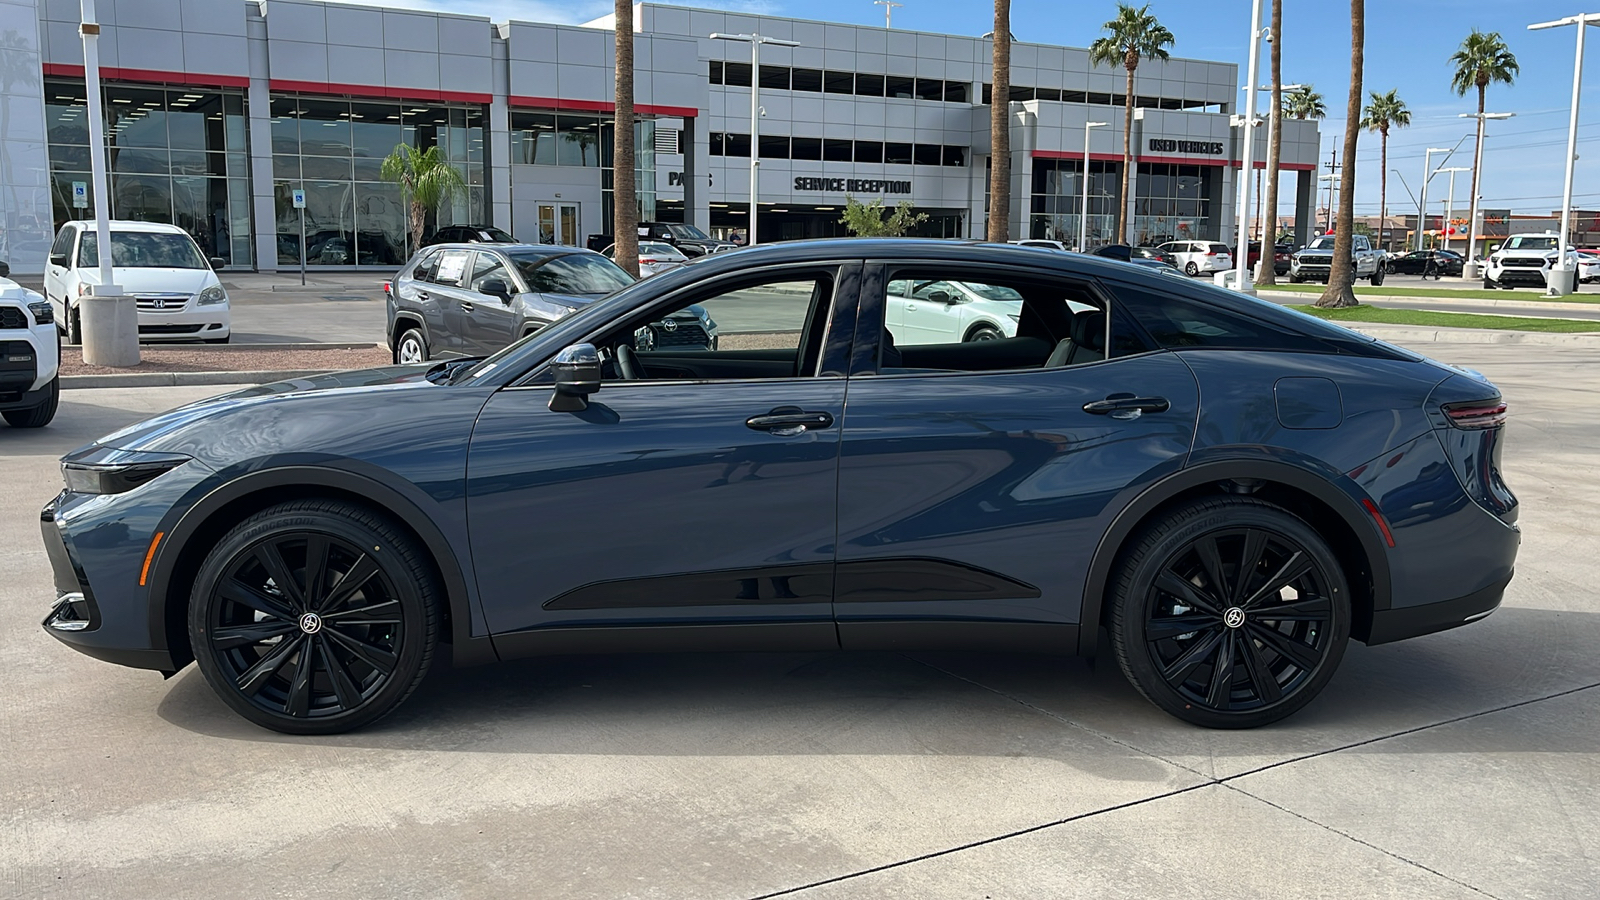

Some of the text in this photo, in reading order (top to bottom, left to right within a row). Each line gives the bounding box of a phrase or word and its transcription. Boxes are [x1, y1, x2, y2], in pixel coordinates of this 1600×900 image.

[1149, 139, 1224, 155] USED VEHICLES
[794, 176, 911, 194] SERVICE RECEPTION
